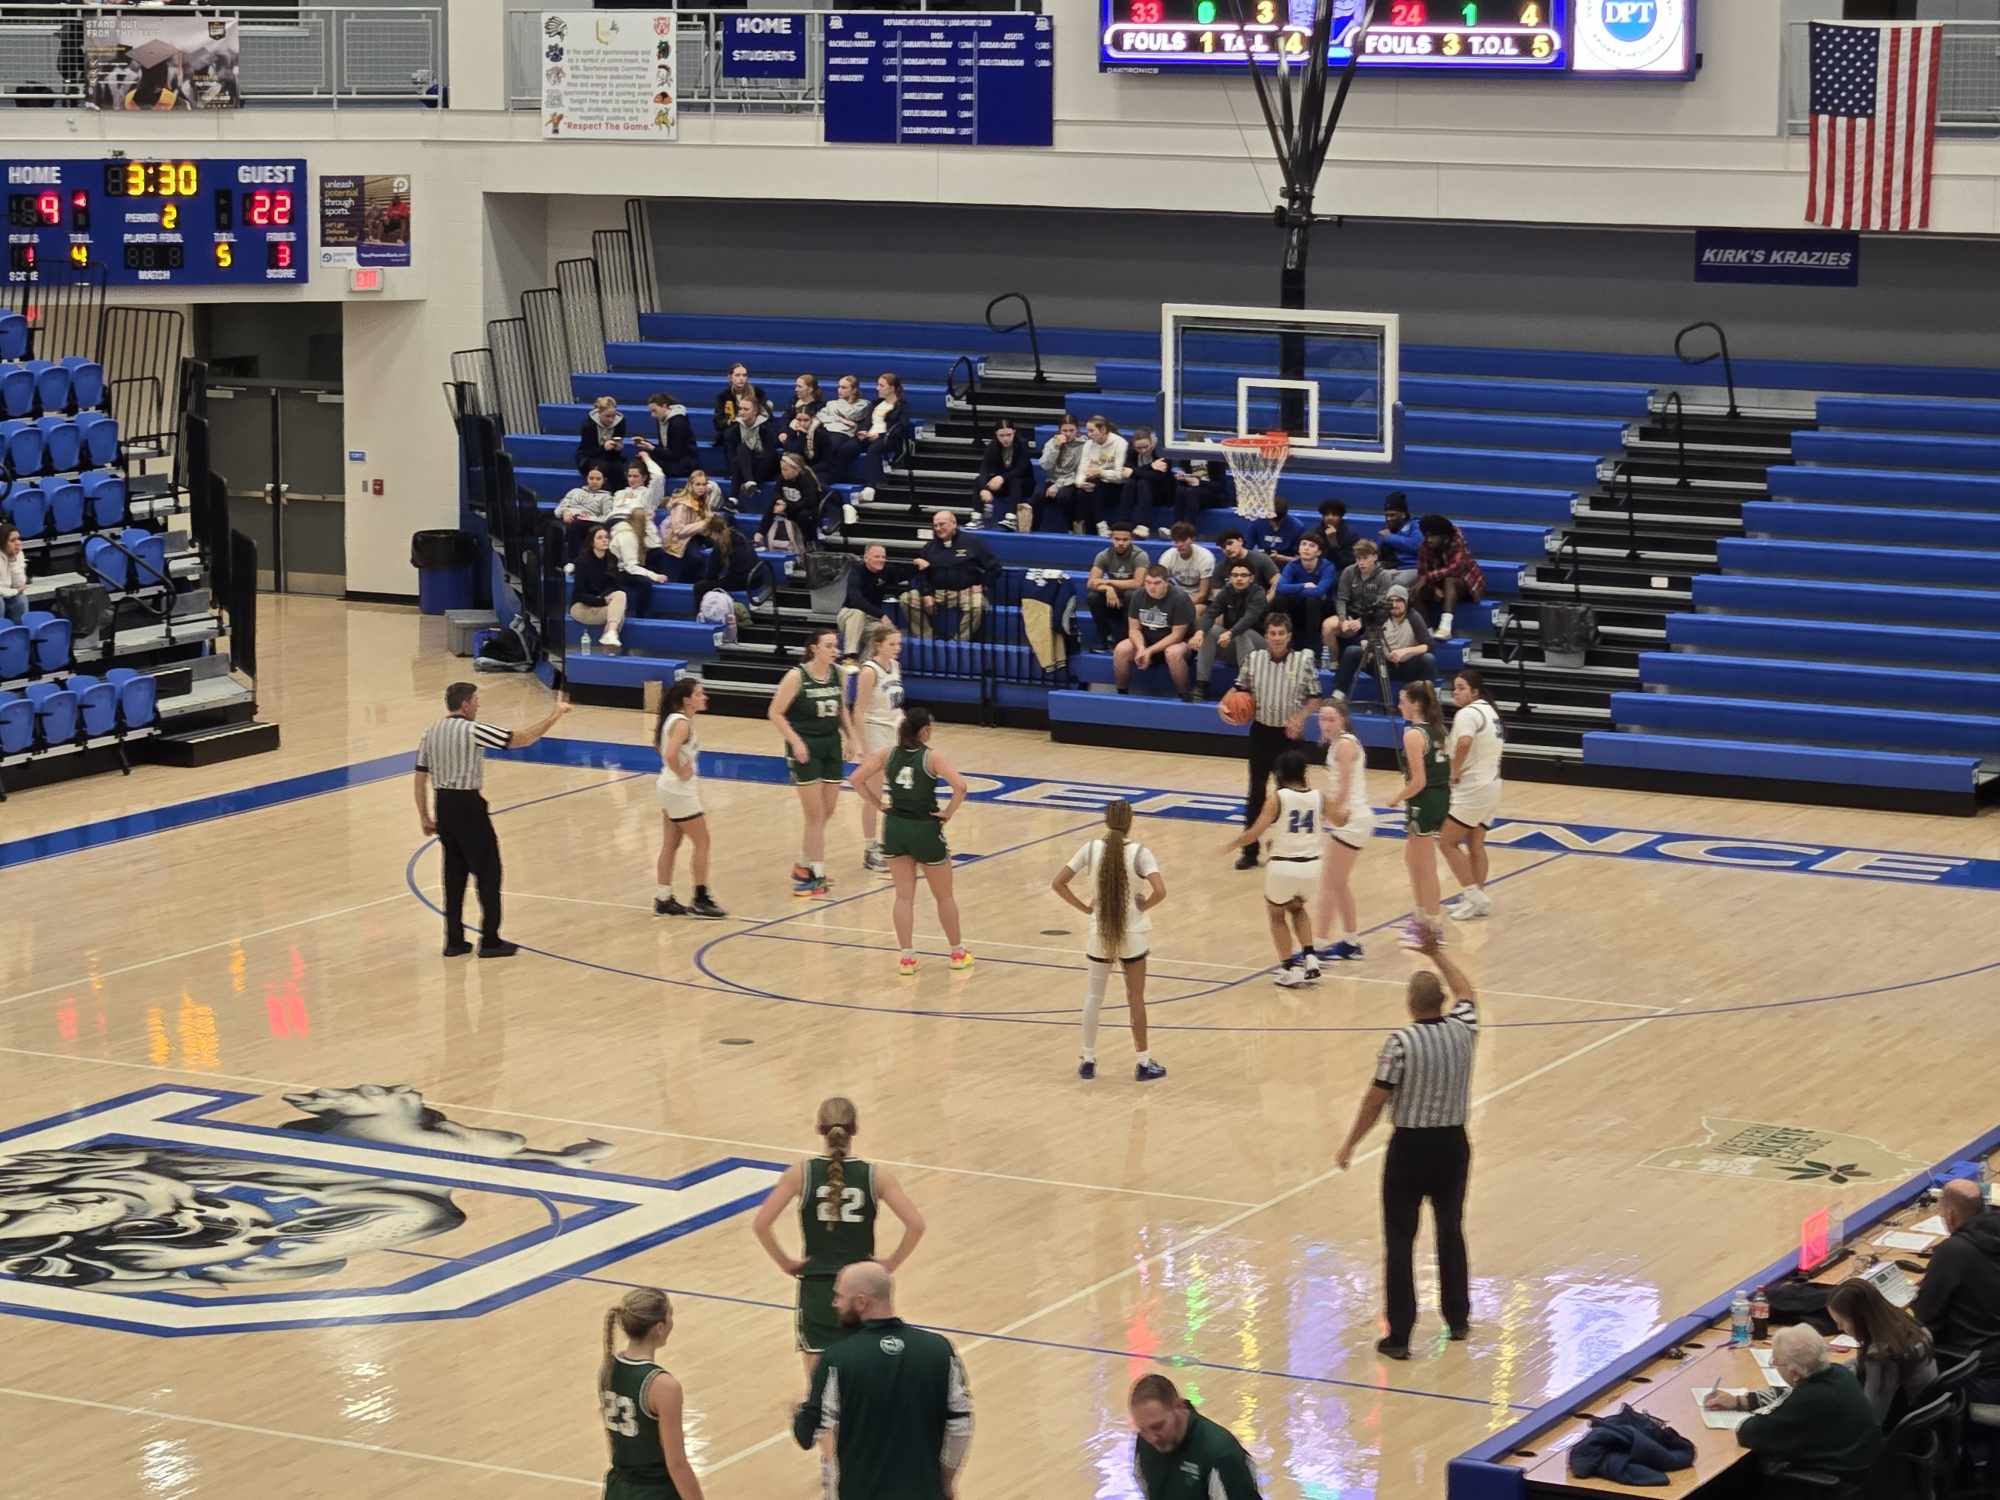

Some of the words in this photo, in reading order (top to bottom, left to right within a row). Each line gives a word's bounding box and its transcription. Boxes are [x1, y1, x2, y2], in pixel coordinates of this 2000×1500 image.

[1131, 2, 1160, 24] 33
[1256, 0, 1275, 24] 3
[1462, 3, 1477, 27] 1
[1519, 3, 1539, 27] 4
[1604, 2, 1653, 25] DPT
[736, 18, 791, 34] HOME
[1122, 32, 1186, 51] FOULS
[1199, 31, 1214, 53] 1
[1285, 32, 1305, 54] 4
[1365, 35, 1432, 54] FOULS
[1442, 33, 1460, 56] 3
[1531, 35, 1551, 58] 5
[732, 49, 796, 62] STUDENTS
[605, 121, 621, 130] The
[8, 166, 62, 185] HOME
[126, 161, 198, 196] 3:30
[237, 165, 297, 184] GUEST
[324, 179, 355, 188] unleash
[40, 195, 60, 225] 9
[252, 195, 292, 225] 22
[324, 198, 355, 209] through
[161, 202, 178, 230] 2
[215, 242, 233, 268] 5
[277, 244, 292, 268] 3
[1701, 248, 1766, 264] KIRK'S
[1768, 250, 1852, 266] KRAZIES
[266, 269, 297, 279] SCORE
[815, 699, 839, 718] 13
[895, 766, 914, 790] 4
[1288, 809, 1314, 834] 24
[815, 1185, 865, 1223] 22
